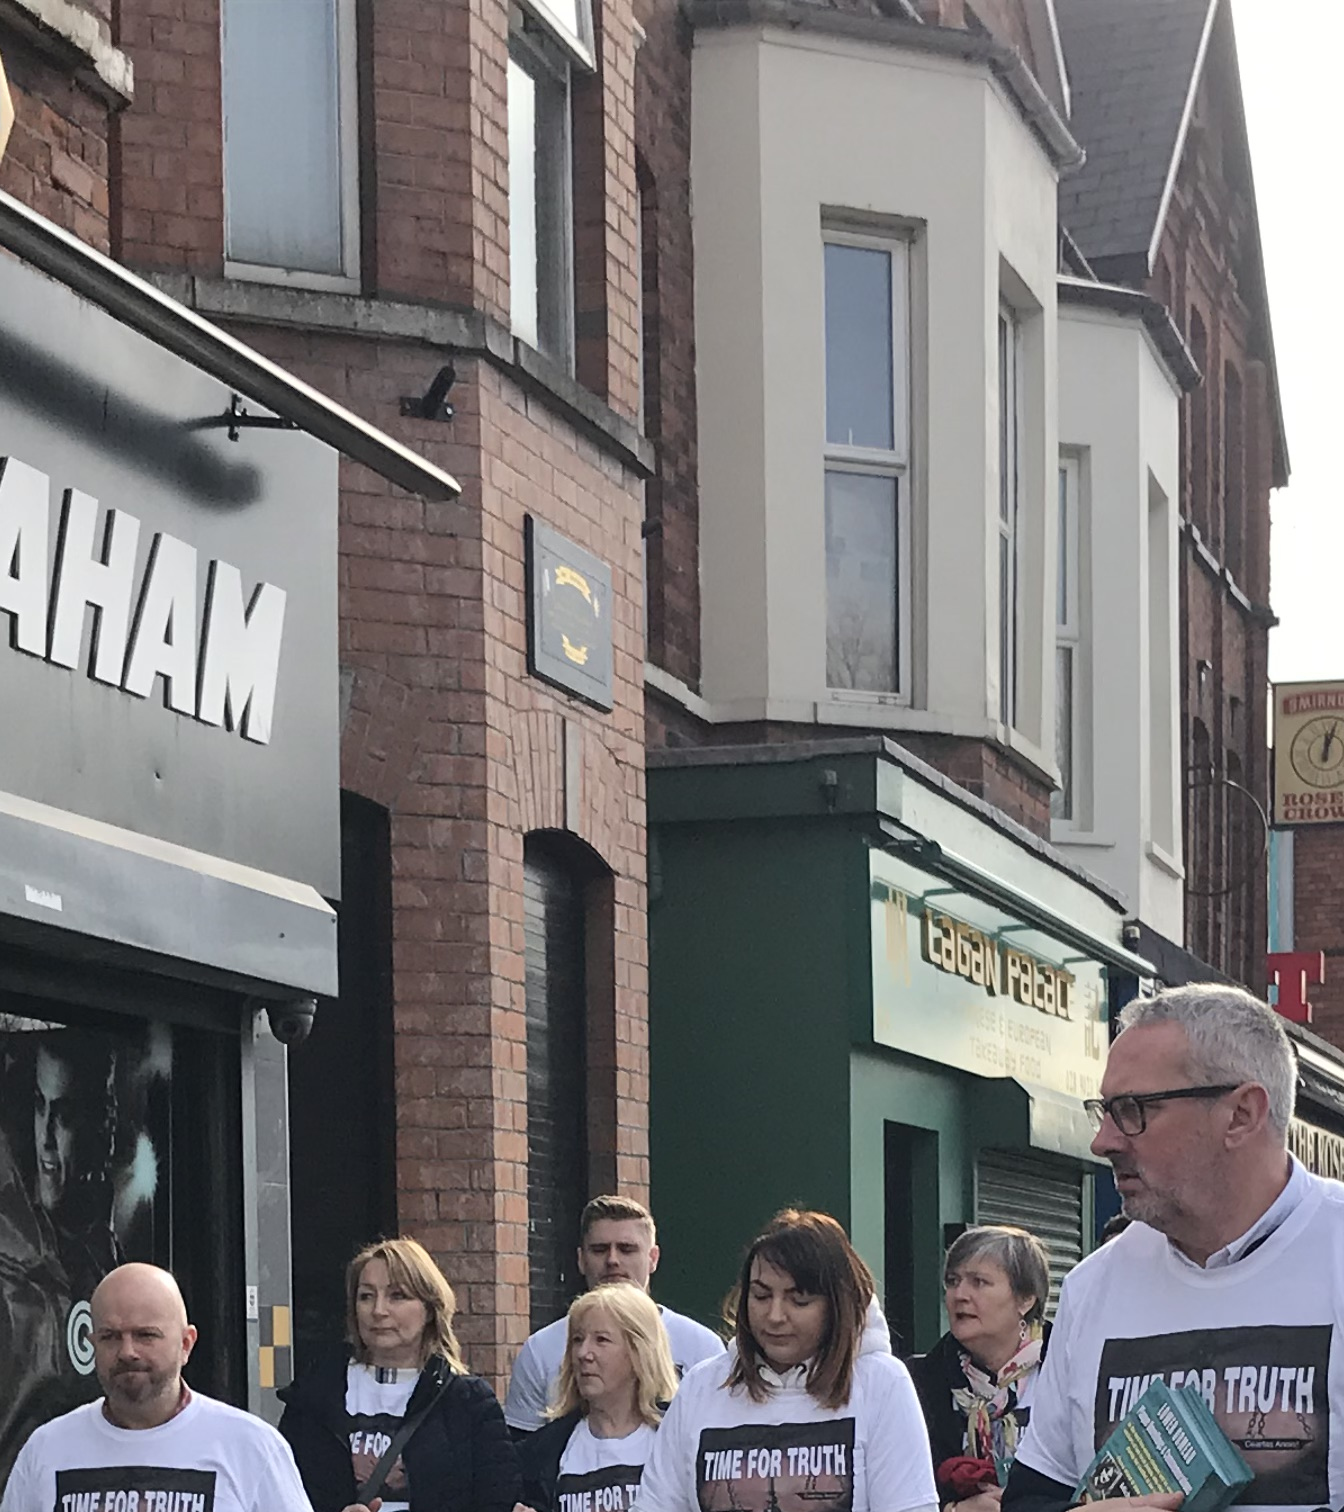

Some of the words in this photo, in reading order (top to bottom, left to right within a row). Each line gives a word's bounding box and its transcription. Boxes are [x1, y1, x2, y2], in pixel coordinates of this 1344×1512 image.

[1283, 790, 1344, 806] ROSE
[1108, 1373, 1164, 1422] TIM
[1223, 1365, 1315, 1414] TRUTH
[704, 1450, 744, 1481] TIME
[747, 1448, 782, 1479] FOR
[787, 1444, 846, 1477] TRUTH
[595, 1485, 623, 1512] FOR
